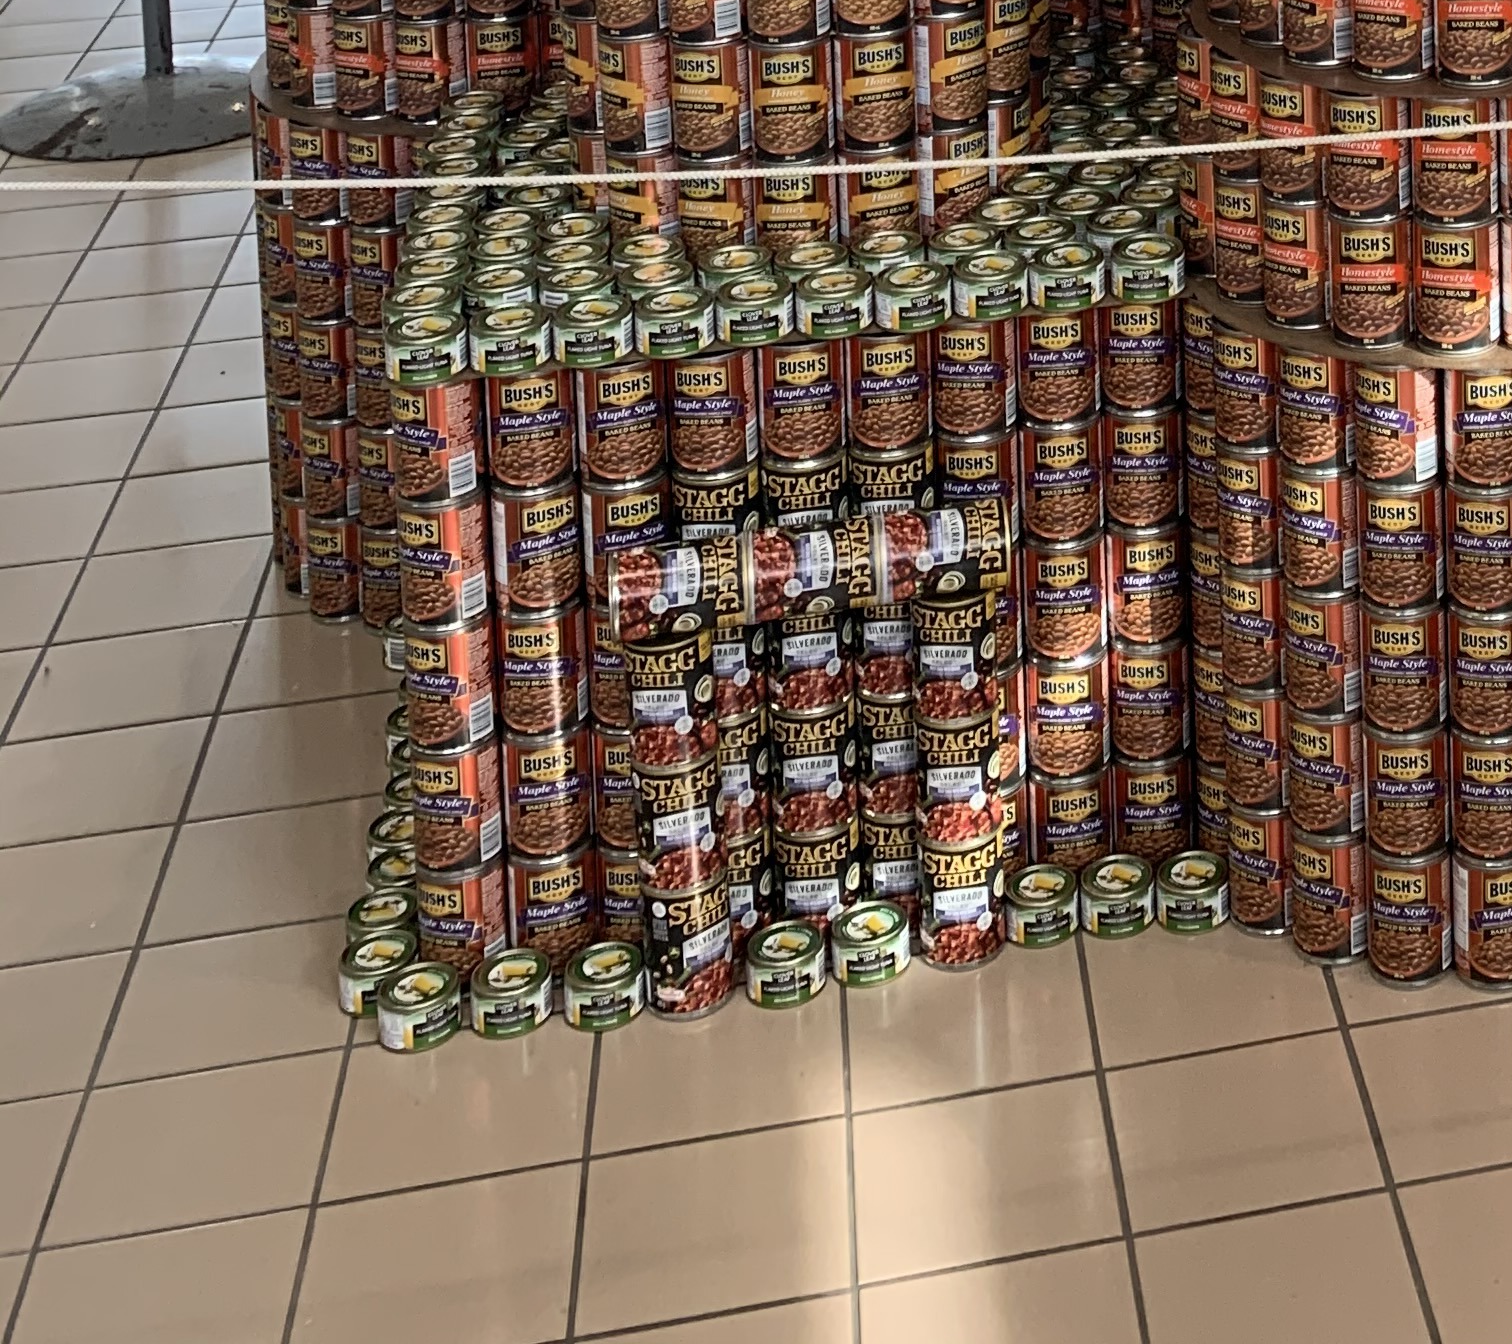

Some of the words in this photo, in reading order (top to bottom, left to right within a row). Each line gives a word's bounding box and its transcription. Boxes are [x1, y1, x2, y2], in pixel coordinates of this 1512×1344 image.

[1343, 234, 1391, 253] BUSH'S
[1423, 238, 1470, 256] BUSH'S
[1341, 265, 1396, 279] Homestyle
[1033, 323, 1079, 341] BUSH'S
[1028, 352, 1060, 366] Maple
[1061, 349, 1087, 365] Style
[504, 383, 555, 402] BUSH'S
[601, 376, 651, 397] BUSH'S
[499, 413, 533, 428] Maple
[535, 411, 561, 424] Style
[1464, 412, 1495, 427] Maple
[1039, 442, 1085, 460] BUSH'S
[768, 468, 839, 498] STAGG
[778, 492, 832, 511] CHILI
[526, 502, 573, 526] BUSH'S
[1369, 504, 1417, 523] BUSH'S
[683, 550, 695, 598] SILVERADO
[702, 545, 716, 600] CHILI
[714, 536, 739, 612] STAGG
[1460, 632, 1508, 650] BUSH'S
[1456, 661, 1487, 675] Maple
[523, 750, 573, 771] BUSH'S
[1380, 753, 1429, 771] BUSH'S
[925, 846, 995, 874] STAGG
[532, 871, 581, 892] BUSH'S
[934, 870, 987, 888] CHILI
[938, 891, 983, 904] SILVERADO
